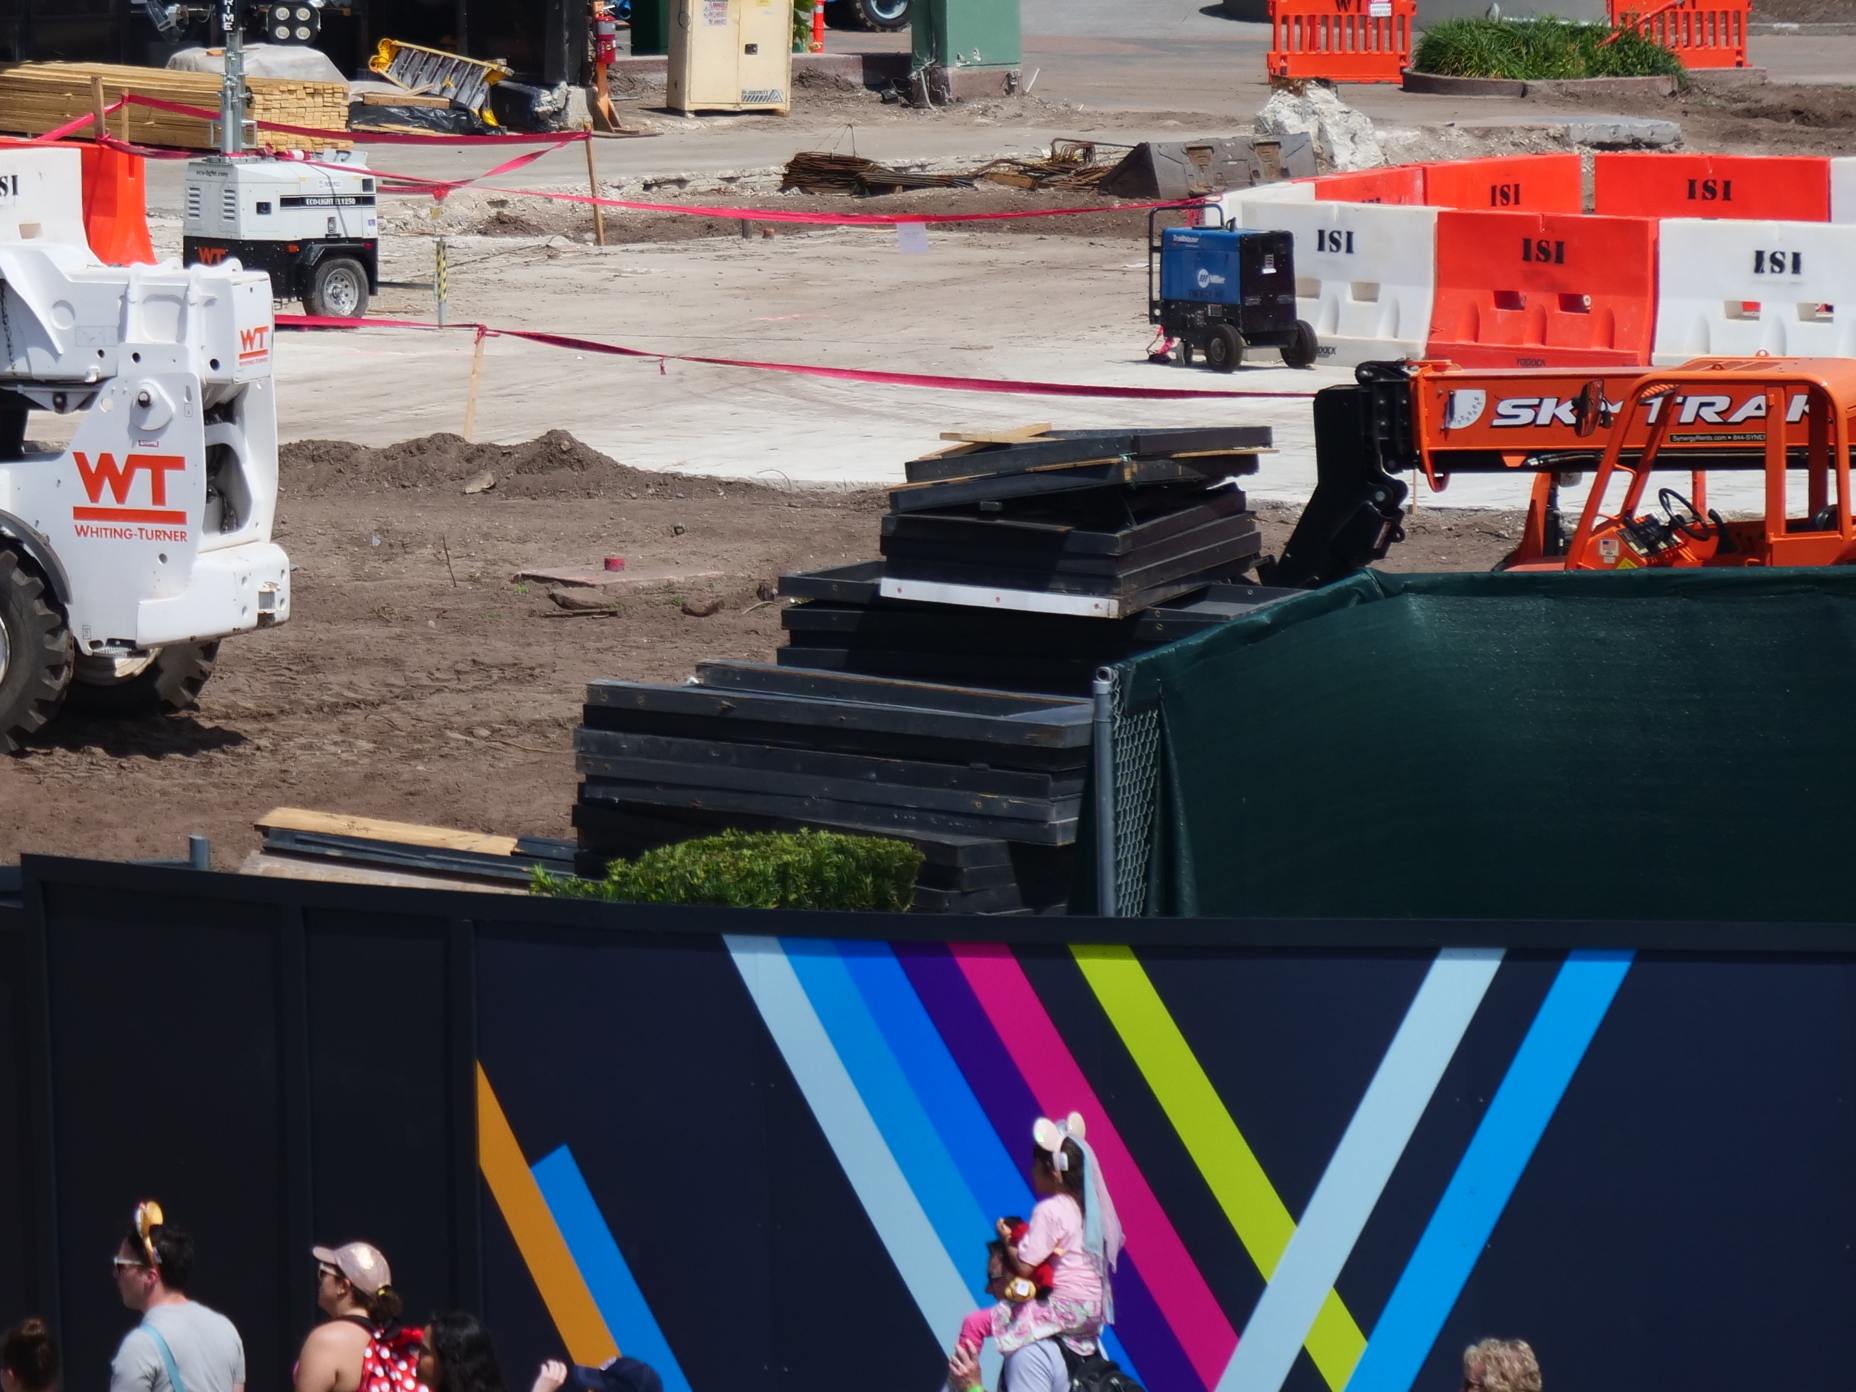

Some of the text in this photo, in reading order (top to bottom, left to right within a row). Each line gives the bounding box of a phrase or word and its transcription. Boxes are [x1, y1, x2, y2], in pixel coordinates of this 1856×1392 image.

[1490, 183, 1521, 207] ISI
[1686, 179, 1732, 202] ISI
[1317, 229, 1355, 254] ISI
[1521, 237, 1566, 264] ISI
[198, 247, 227, 265] WT
[1753, 249, 1803, 275] ISI
[1209, 274, 1226, 285] Miller
[240, 325, 270, 351] WT
[73, 451, 186, 506] WT
[74, 524, 188, 542] WHITING-TURNER
